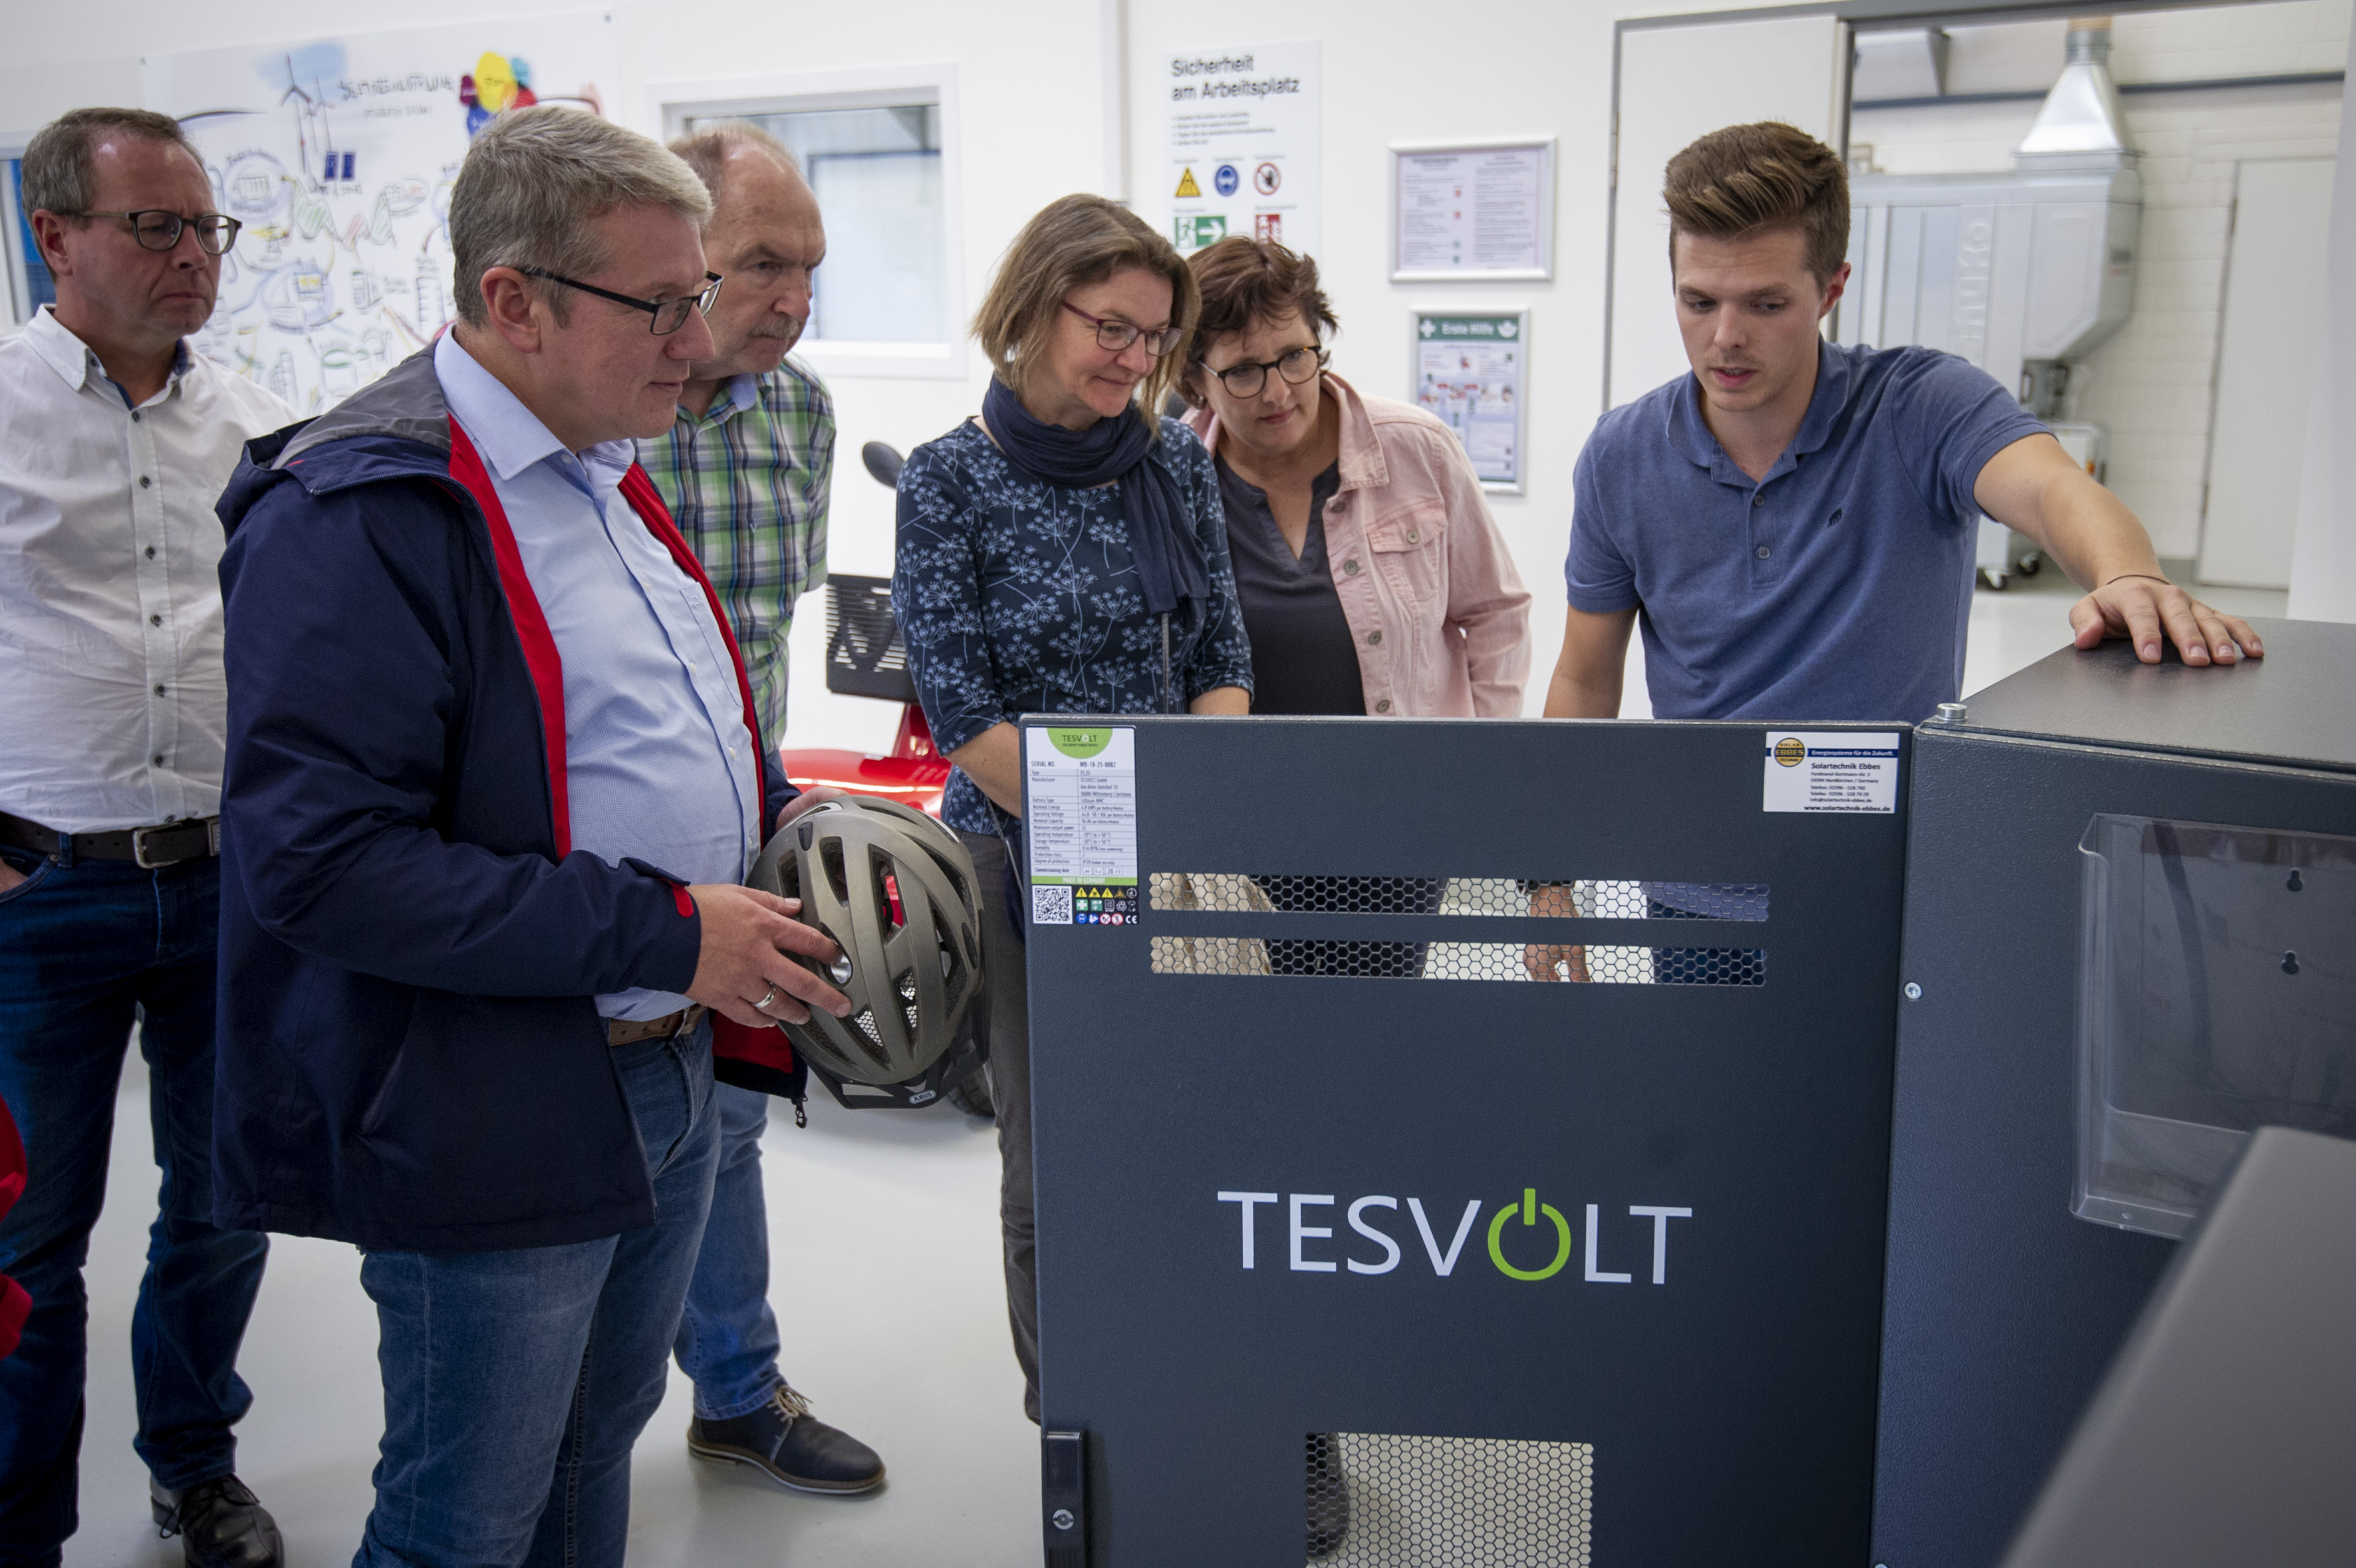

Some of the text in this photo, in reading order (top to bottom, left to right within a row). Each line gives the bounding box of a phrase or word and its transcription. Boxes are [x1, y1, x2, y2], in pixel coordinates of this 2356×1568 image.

[1171, 55, 1254, 76] Sicherheit
[1172, 78, 1300, 100] am Arbeitsplatz
[914, 1093, 932, 1101] ABUS
[1217, 1188, 1693, 1285] TESVOLT
